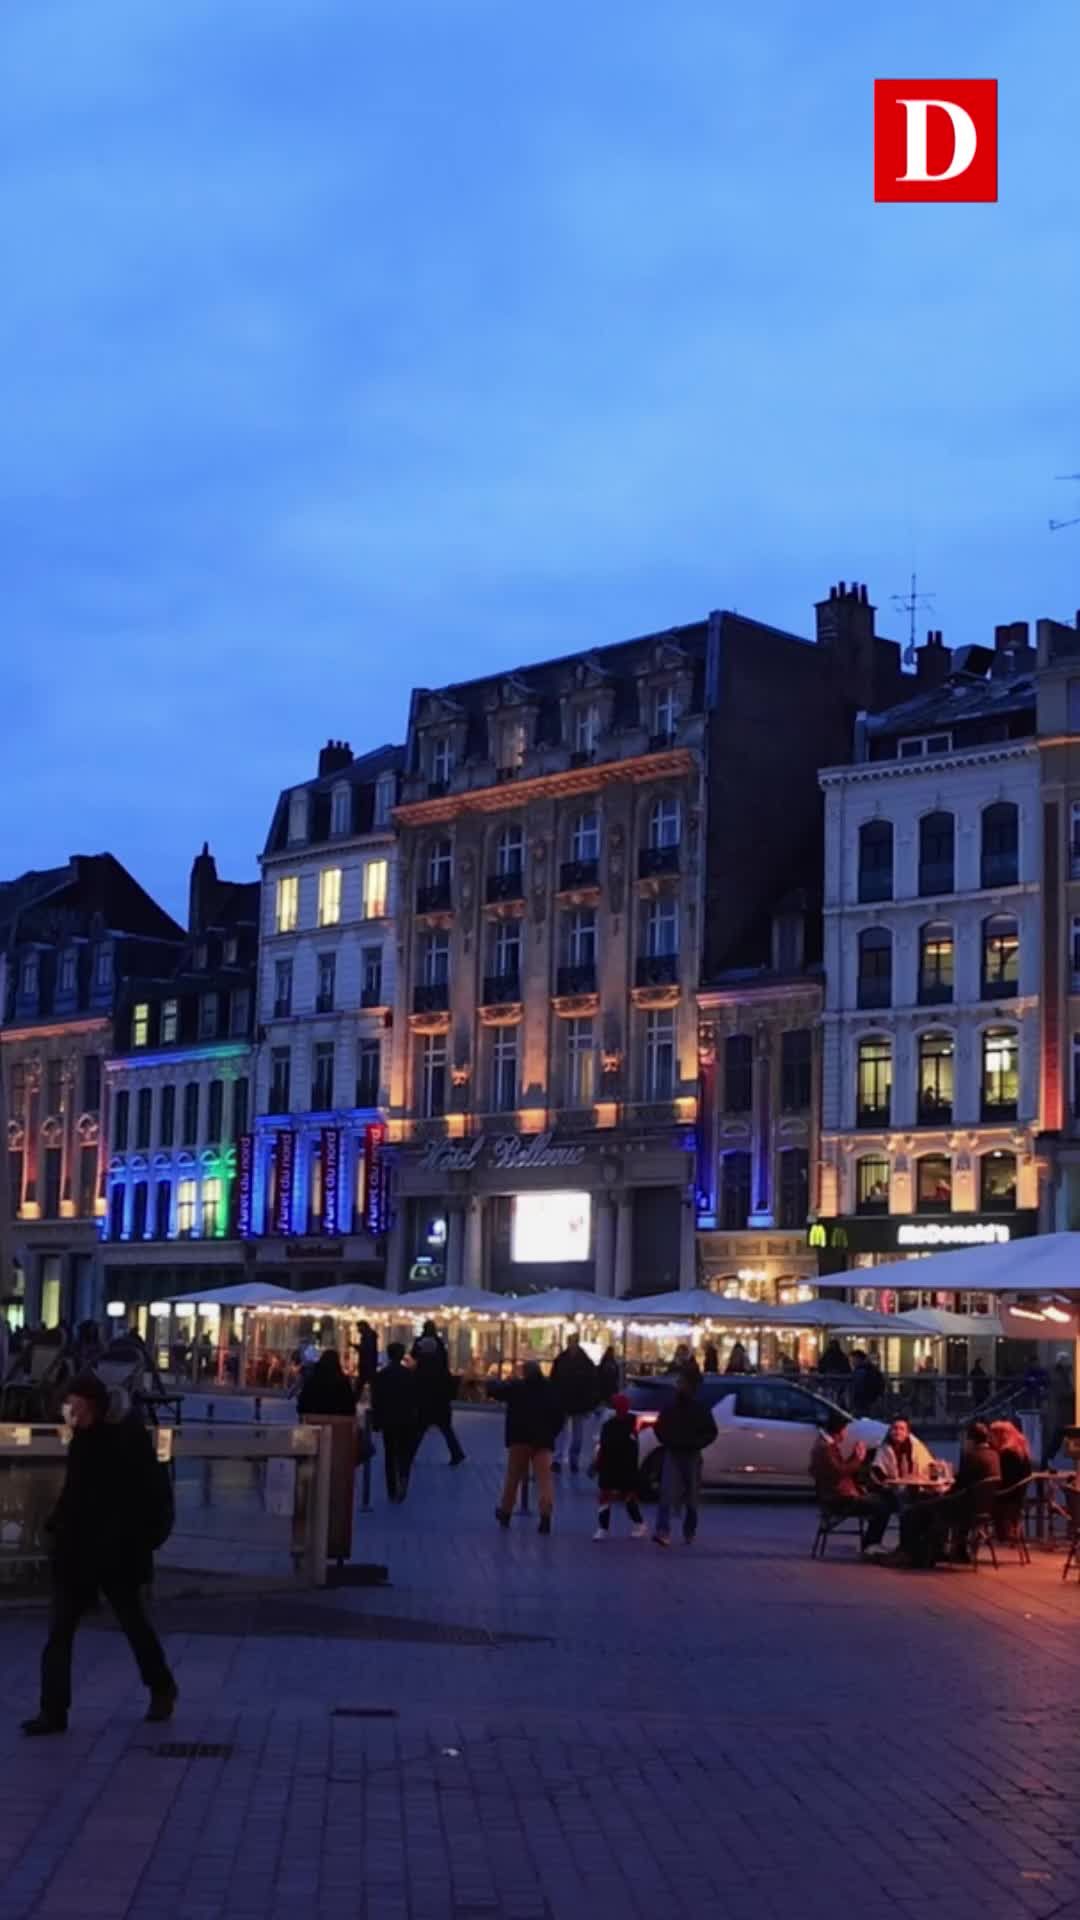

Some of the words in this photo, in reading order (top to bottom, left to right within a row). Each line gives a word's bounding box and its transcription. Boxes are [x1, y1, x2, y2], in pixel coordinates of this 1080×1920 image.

[239, 1172, 249, 1191] du
[279, 1170, 290, 1189] du
[325, 1168, 335, 1188] du
[368, 1167, 379, 1186] du
